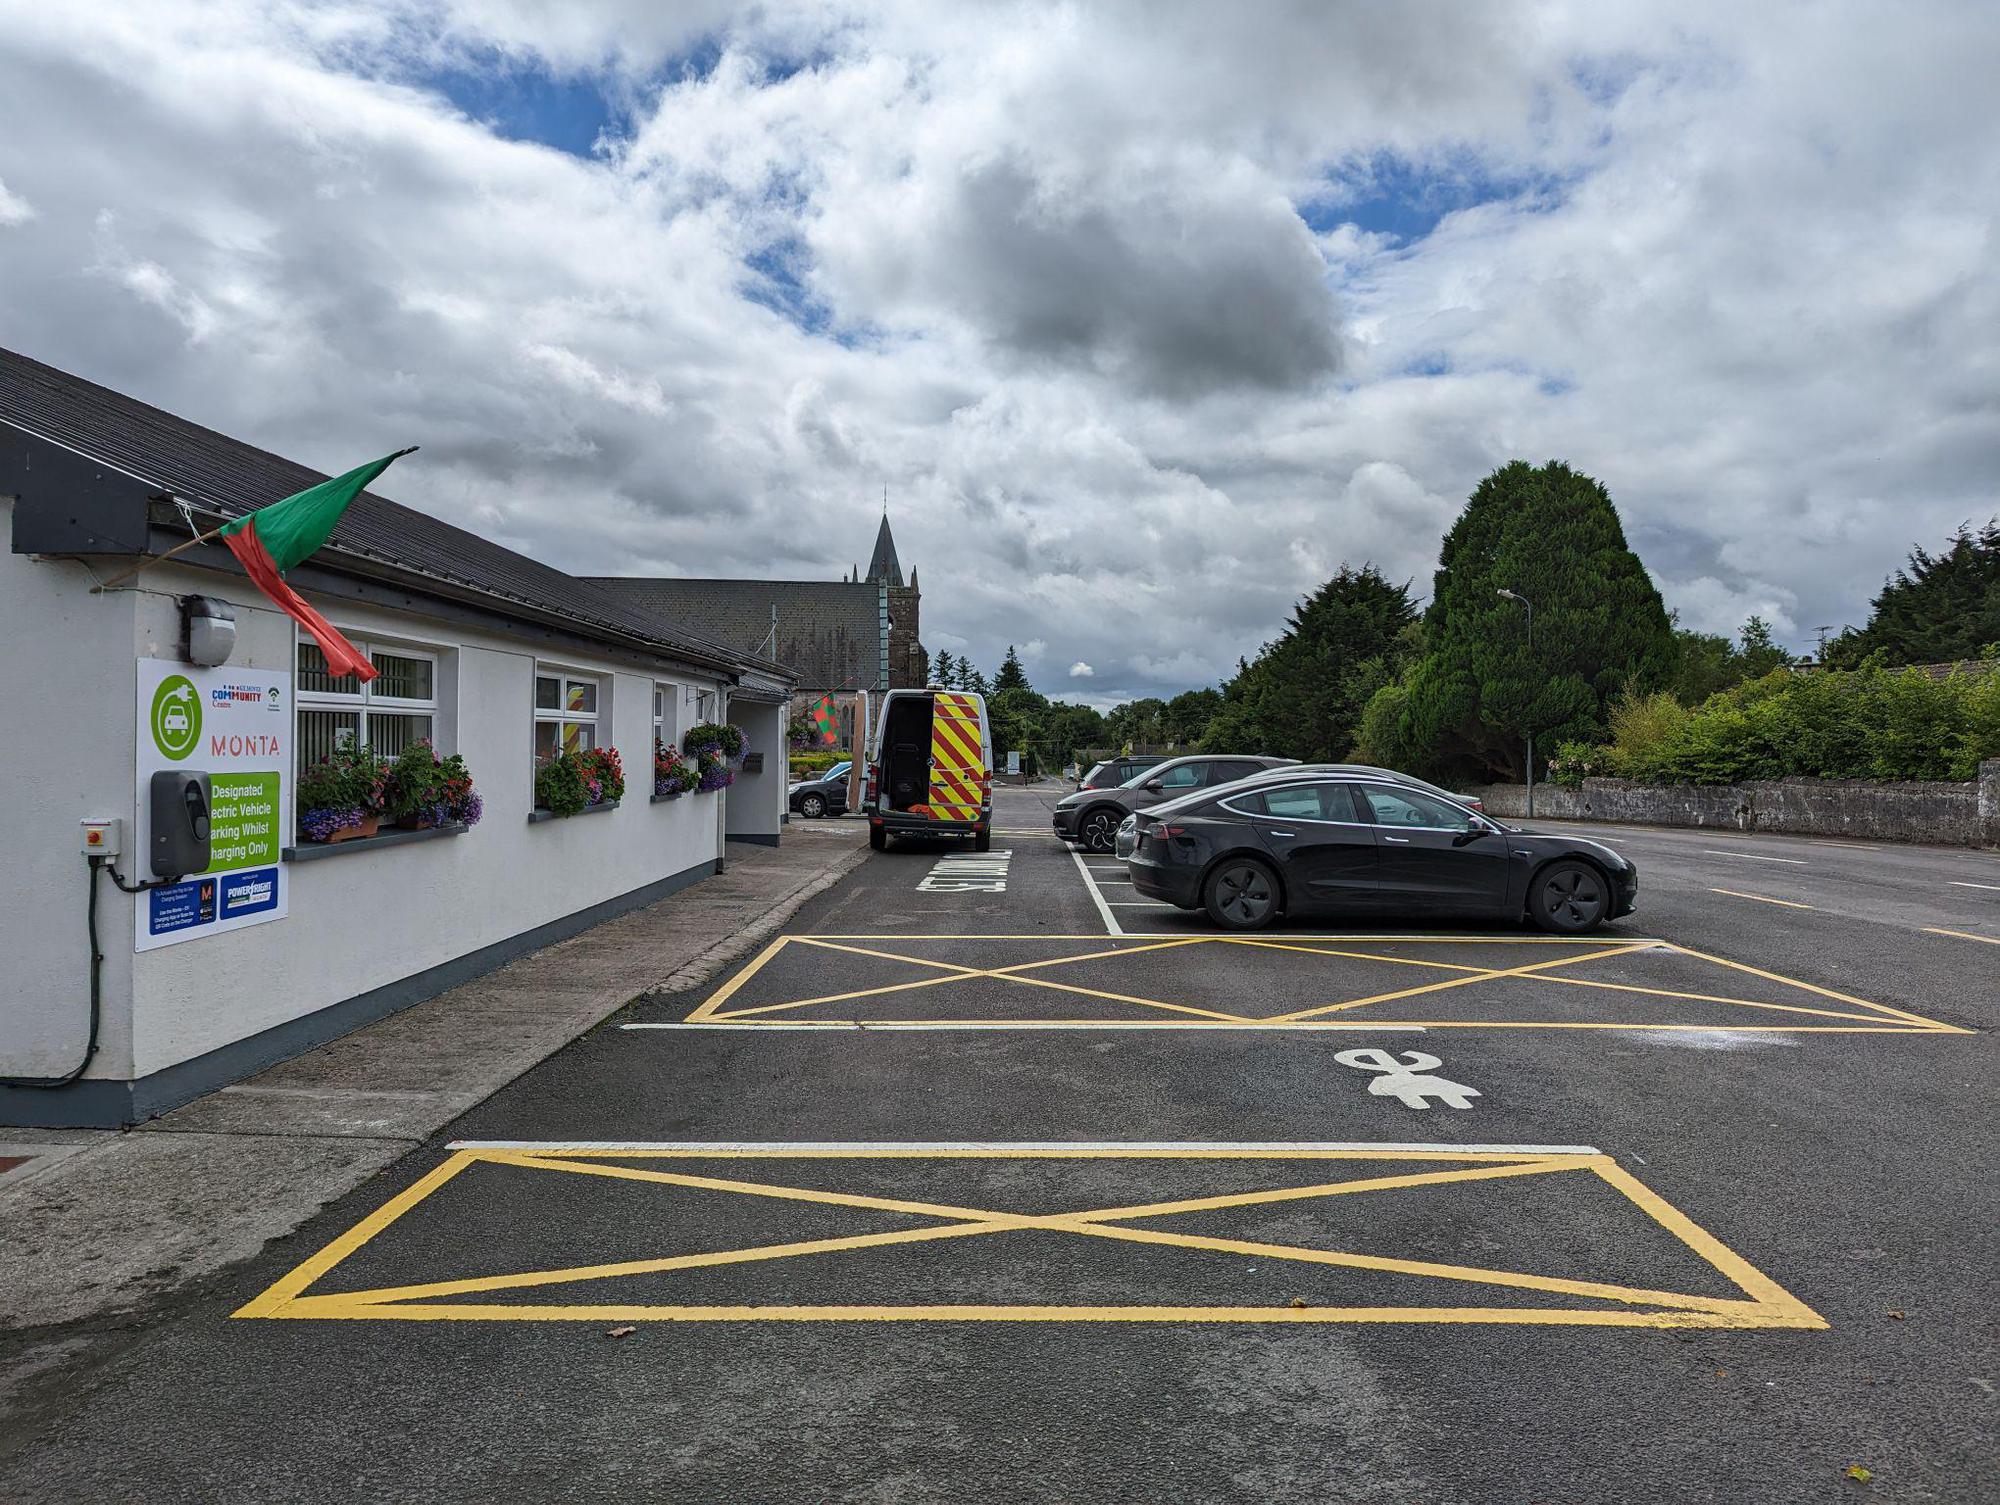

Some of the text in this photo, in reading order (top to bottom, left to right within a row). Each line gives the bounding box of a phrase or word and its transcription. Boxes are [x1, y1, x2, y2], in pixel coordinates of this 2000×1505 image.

[212, 690, 261, 702] COMMUNITY
[212, 699, 231, 708] Centre
[211, 735, 280, 757] MONTA
[212, 783, 263, 800] Designated
[211, 803, 271, 819] ectric Vehicle
[211, 822, 269, 840] arking Whilst
[211, 841, 269, 861] harging Only
[228, 886, 251, 898] POWER
